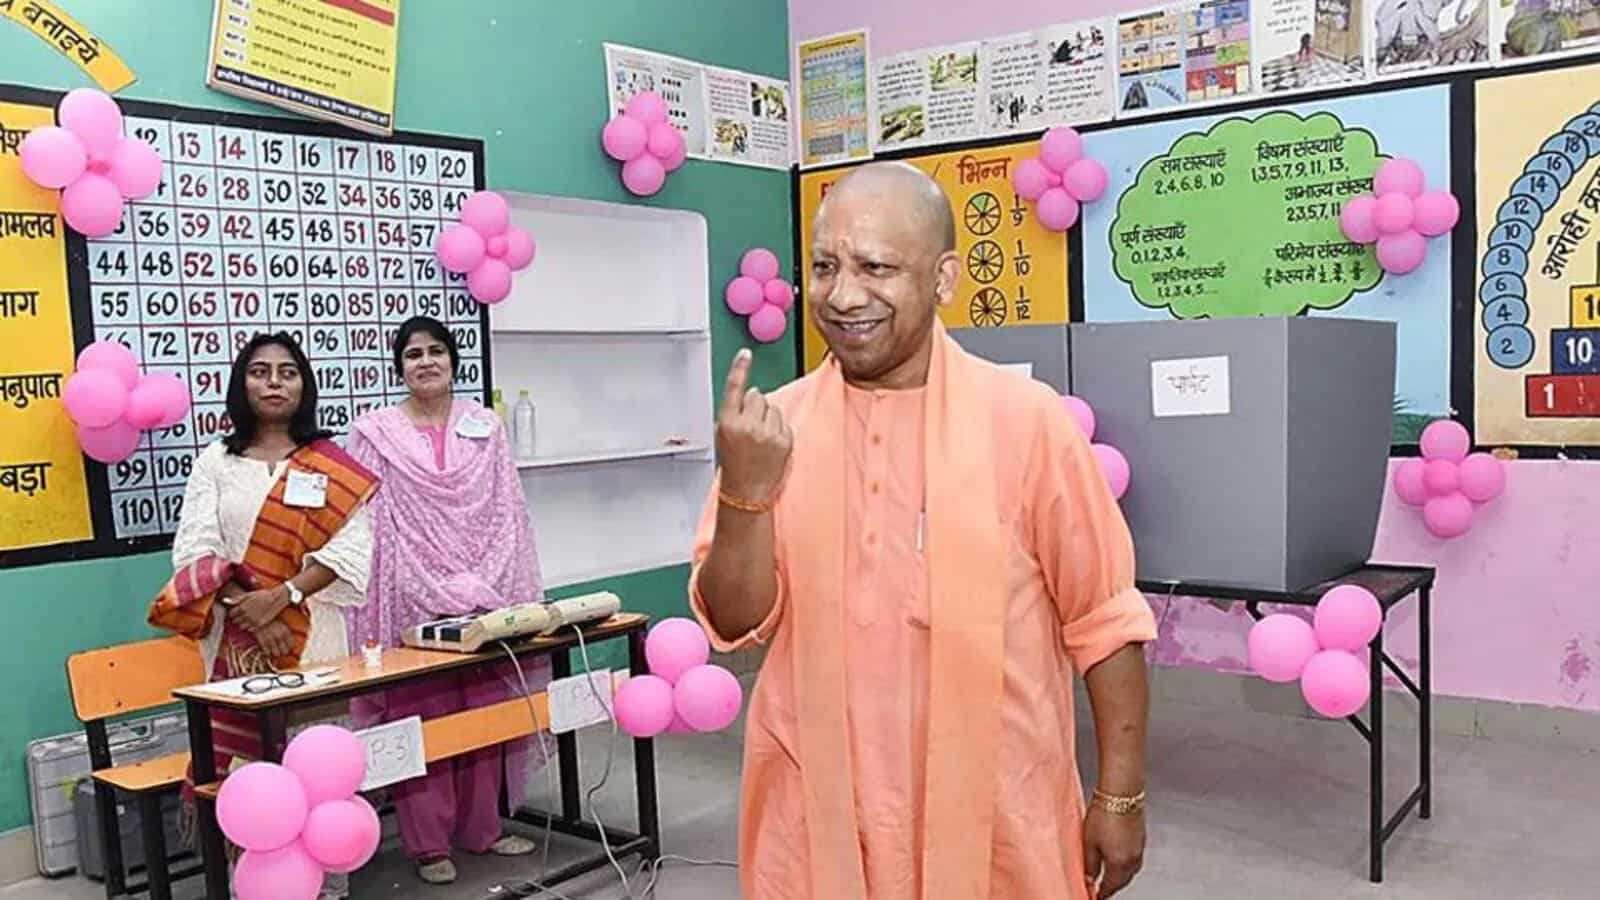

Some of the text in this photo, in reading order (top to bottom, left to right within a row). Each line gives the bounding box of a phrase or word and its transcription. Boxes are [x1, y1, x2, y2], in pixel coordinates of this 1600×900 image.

[178, 132, 201, 158] 13
[219, 135, 246, 159] 14
[262, 140, 283, 164] 15
[300, 142, 320, 167] 16
[338, 147, 359, 169] 17
[377, 150, 396, 173] 18
[410, 154, 426, 175] 19
[441, 156, 466, 178] 20
[1565, 136, 1580, 153] 18
[957, 155, 1011, 186] भिन्न
[1547, 156, 1561, 170] 16
[180, 174, 208, 197] 26
[223, 177, 250, 200] 28
[264, 179, 292, 203] 30
[302, 182, 326, 205] 32
[339, 184, 367, 207] 34
[376, 187, 401, 209] 36
[409, 189, 433, 211] 38
[1531, 176, 1548, 193] 14
[1513, 200, 1529, 215] 12
[138, 211, 170, 237] 36
[181, 213, 210, 238] 39
[224, 215, 253, 239] 42
[265, 217, 294, 241] 45
[306, 220, 333, 242] 48
[344, 221, 366, 243] 51
[379, 221, 405, 247] 54
[411, 225, 435, 246] 57
[1504, 223, 1520, 240] 10
[96, 250, 128, 276] 44
[141, 251, 173, 276] 48
[184, 252, 214, 278] 52
[228, 254, 257, 278] 56
[269, 254, 298, 278] 60
[308, 255, 337, 279] 64
[345, 256, 369, 278] 68
[380, 258, 404, 279] 72
[414, 259, 435, 280] 76
[1498, 248, 1510, 265] 8
[1495, 277, 1507, 292] 6
[101, 292, 477, 317] 55 60 65 70 75 80 85 90 95 100
[1496, 303, 1512, 321] 4
[148, 331, 177, 357] 72
[191, 331, 220, 354] 78
[314, 330, 338, 350] 96
[351, 329, 377, 350] 102
[454, 329, 476, 349] 20
[1501, 338, 1515, 354] 2
[1566, 337, 1593, 364] 10
[196, 372, 221, 396] 91
[317, 366, 345, 390] 112
[353, 366, 379, 390] 119
[1544, 382, 1555, 409] 1
[318, 406, 349, 427] 128
[116, 455, 193, 486] 99 108
[120, 498, 154, 527] 110
